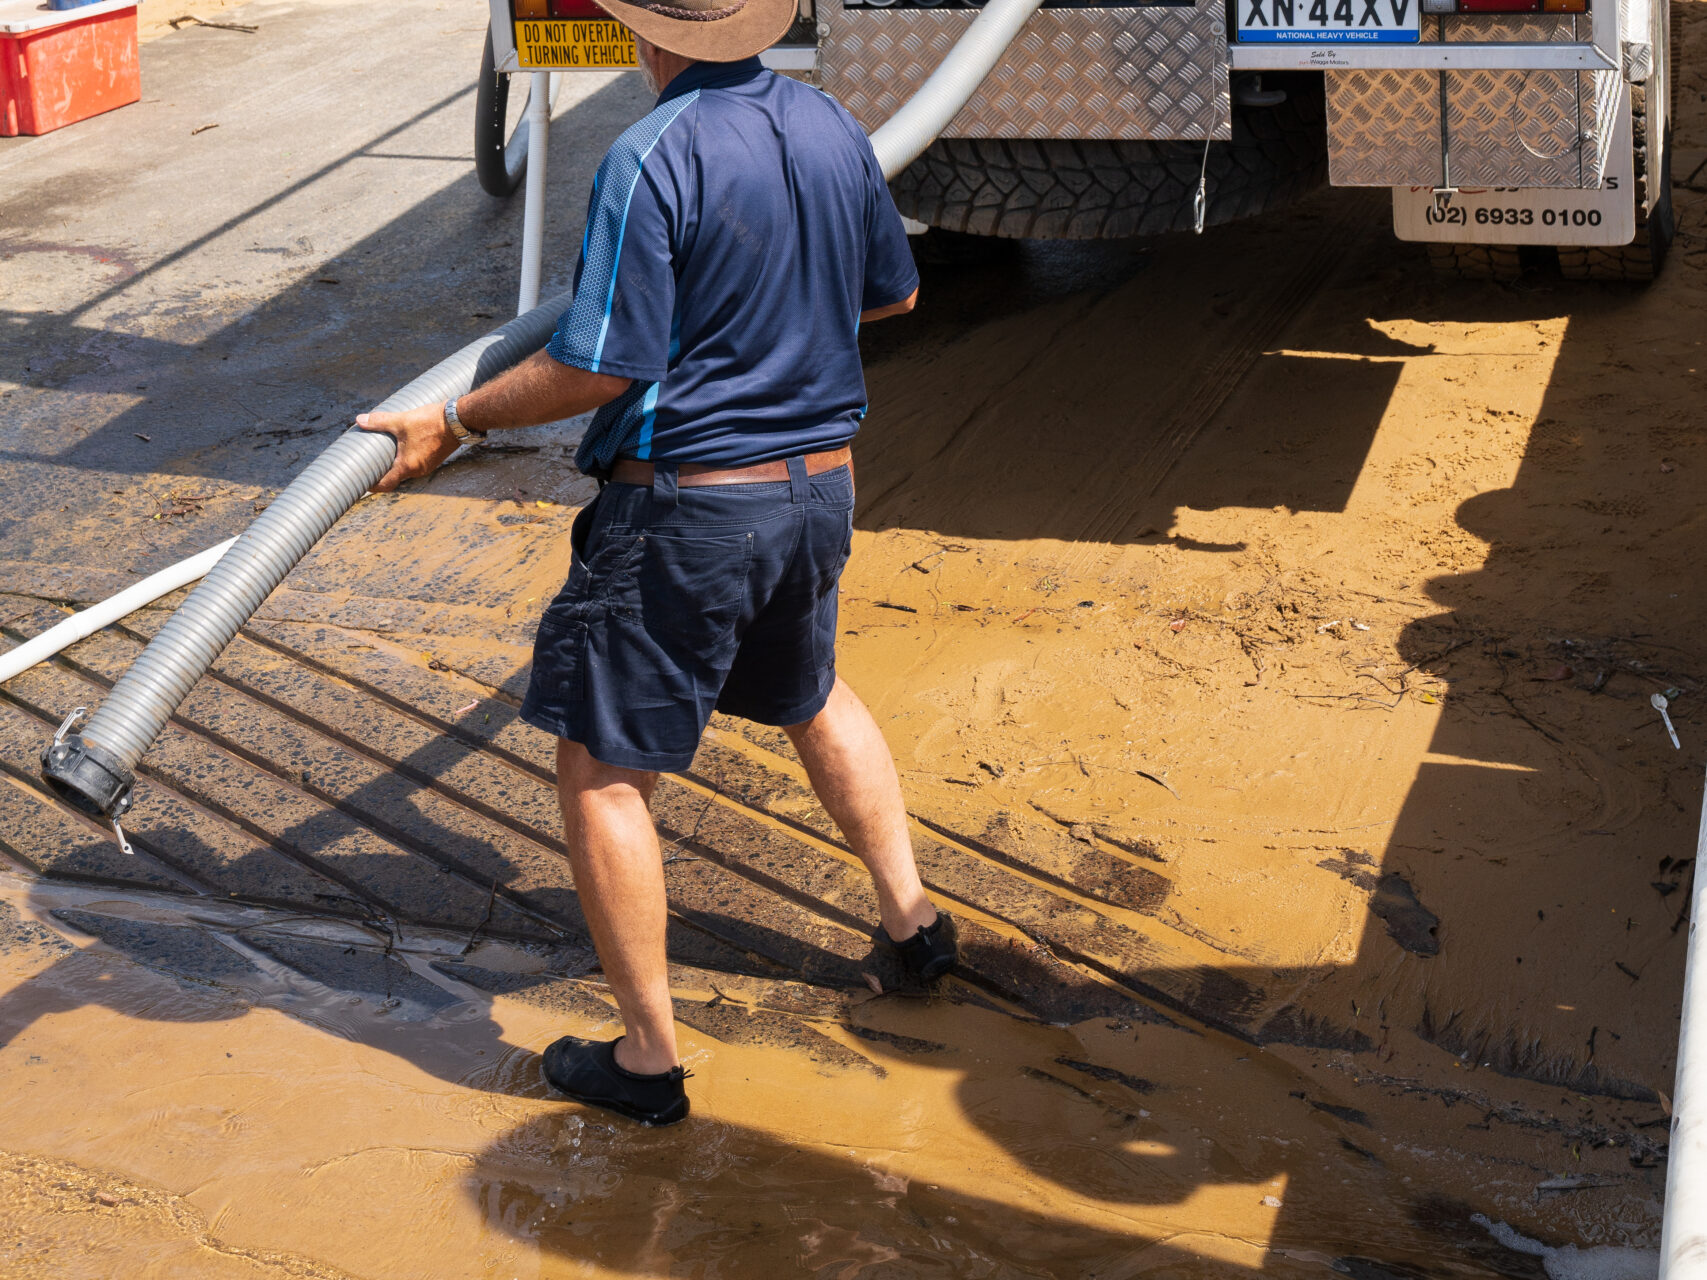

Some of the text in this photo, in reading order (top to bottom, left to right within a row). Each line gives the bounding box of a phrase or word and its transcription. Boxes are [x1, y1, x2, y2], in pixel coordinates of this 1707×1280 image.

[524, 23, 635, 43] DO NOT OVERTAKE
[527, 45, 635, 65] TURNING VEHICLE
[1425, 205, 1602, 226] (02) 6933 0100
